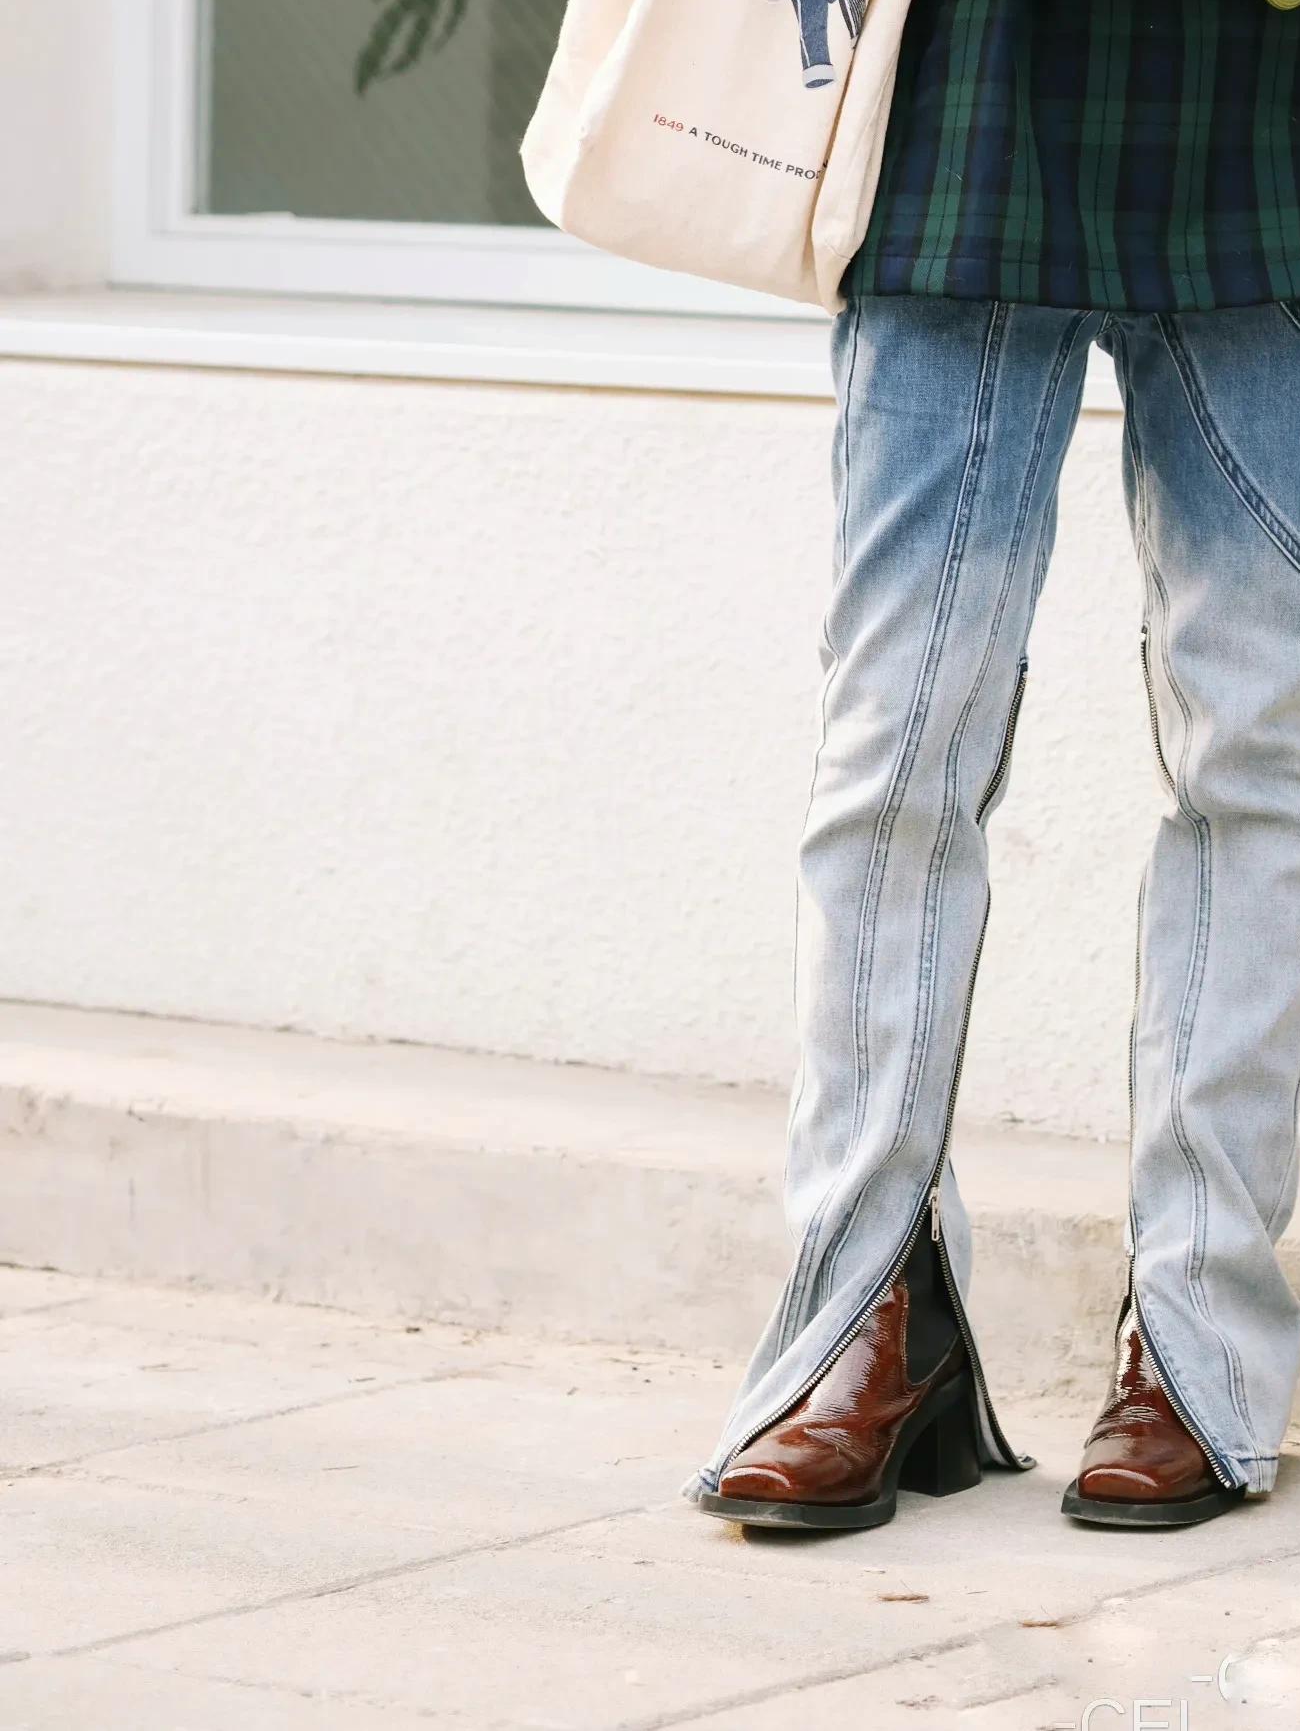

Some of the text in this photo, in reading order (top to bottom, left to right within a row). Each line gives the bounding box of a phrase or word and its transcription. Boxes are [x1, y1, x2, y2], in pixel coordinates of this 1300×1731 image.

[653, 113, 684, 132] 1849
[688, 126, 698, 137] A
[704, 131, 748, 157] TOUGH
[752, 152, 783, 170] TIME
